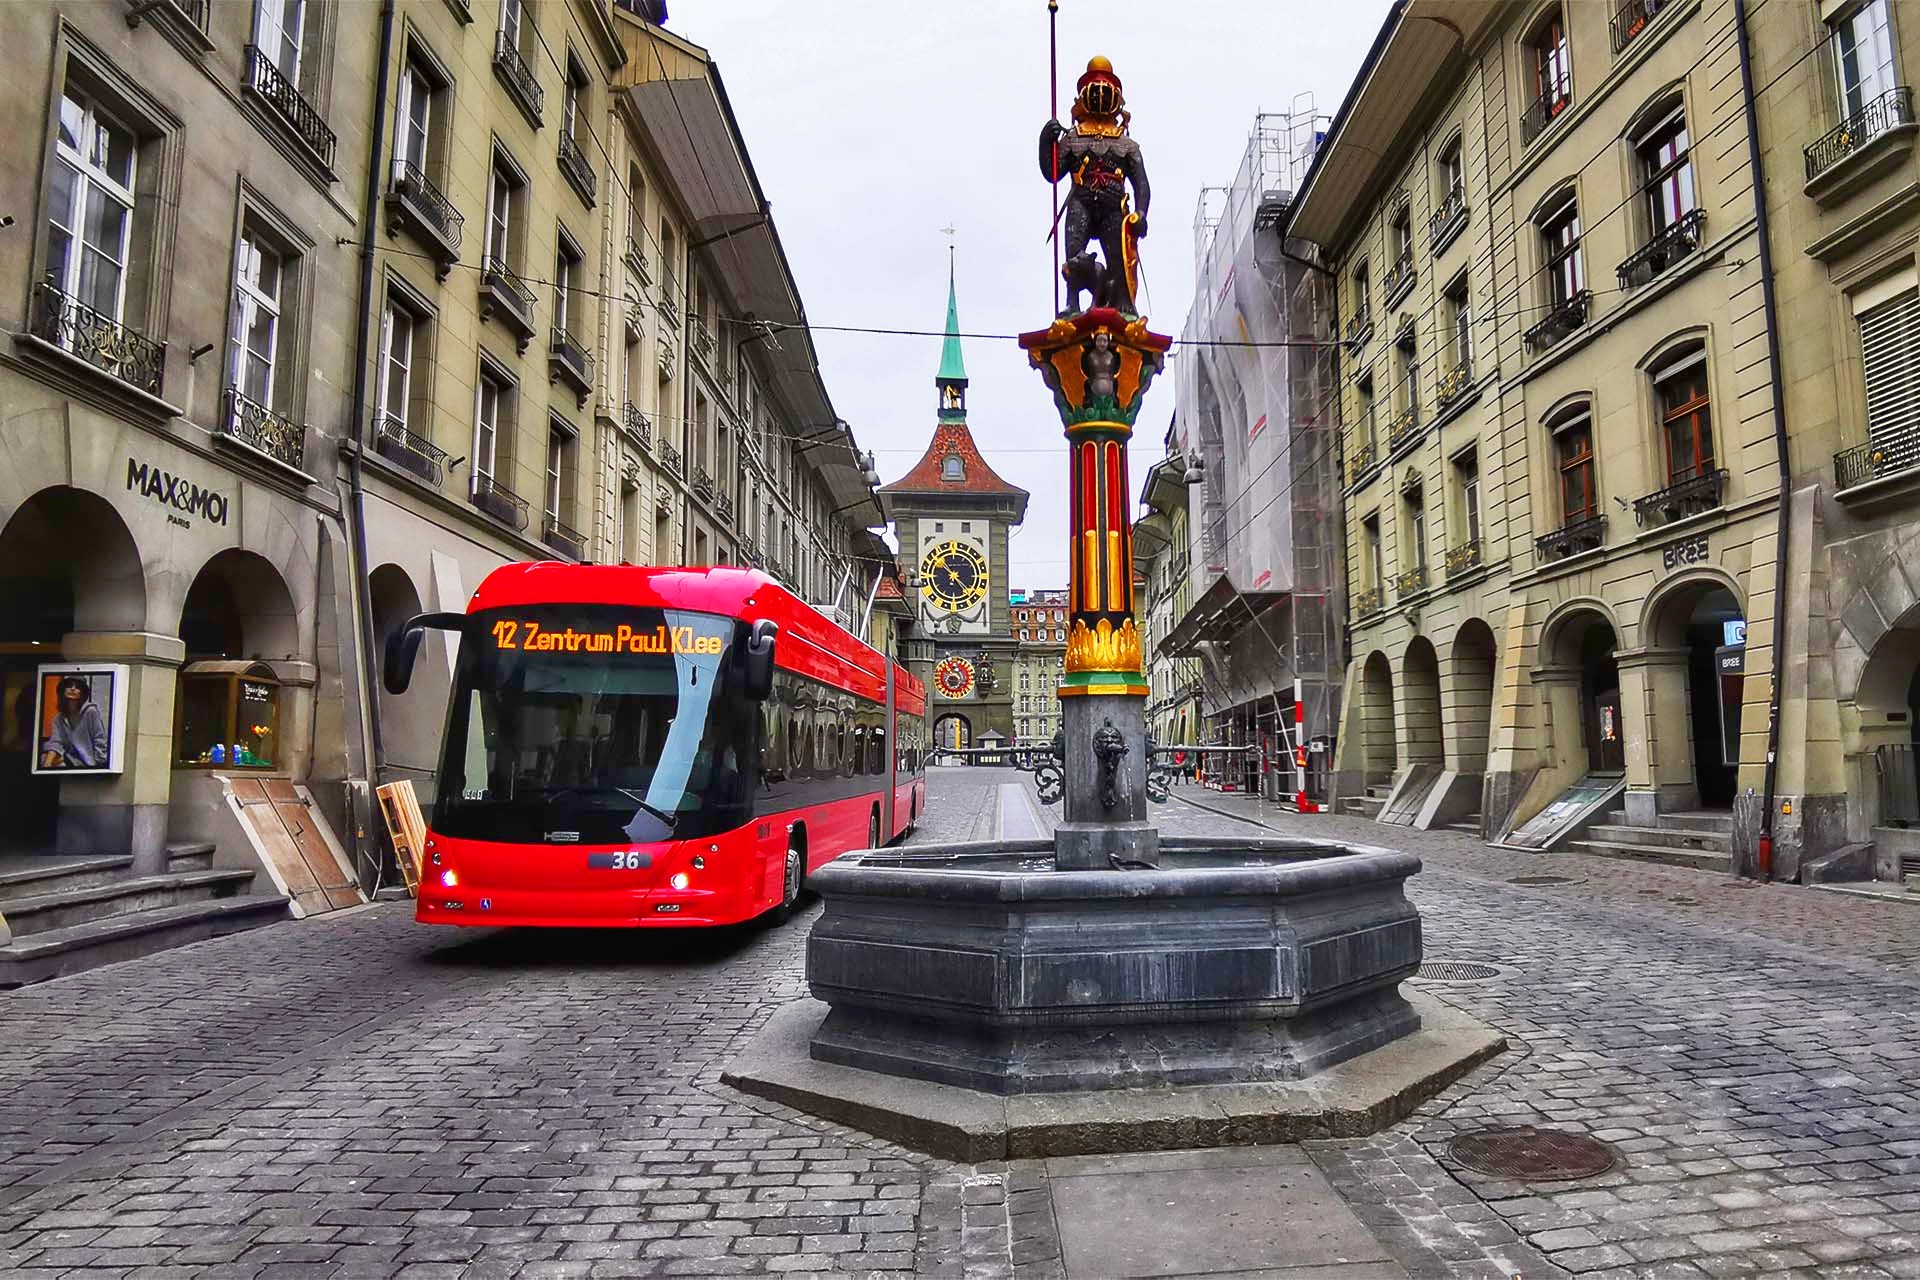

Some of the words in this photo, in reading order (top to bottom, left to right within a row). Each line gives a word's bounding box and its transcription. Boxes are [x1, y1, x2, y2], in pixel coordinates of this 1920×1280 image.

[127, 457, 228, 526] MAX&MOI
[167, 514, 190, 529] PARIS
[1663, 535, 1709, 570] BREE
[492, 621, 518, 649] 12
[523, 623, 614, 653] Zentrum
[616, 625, 667, 653] Paul
[671, 626, 723, 654] Klee
[612, 851, 640, 870] 36
